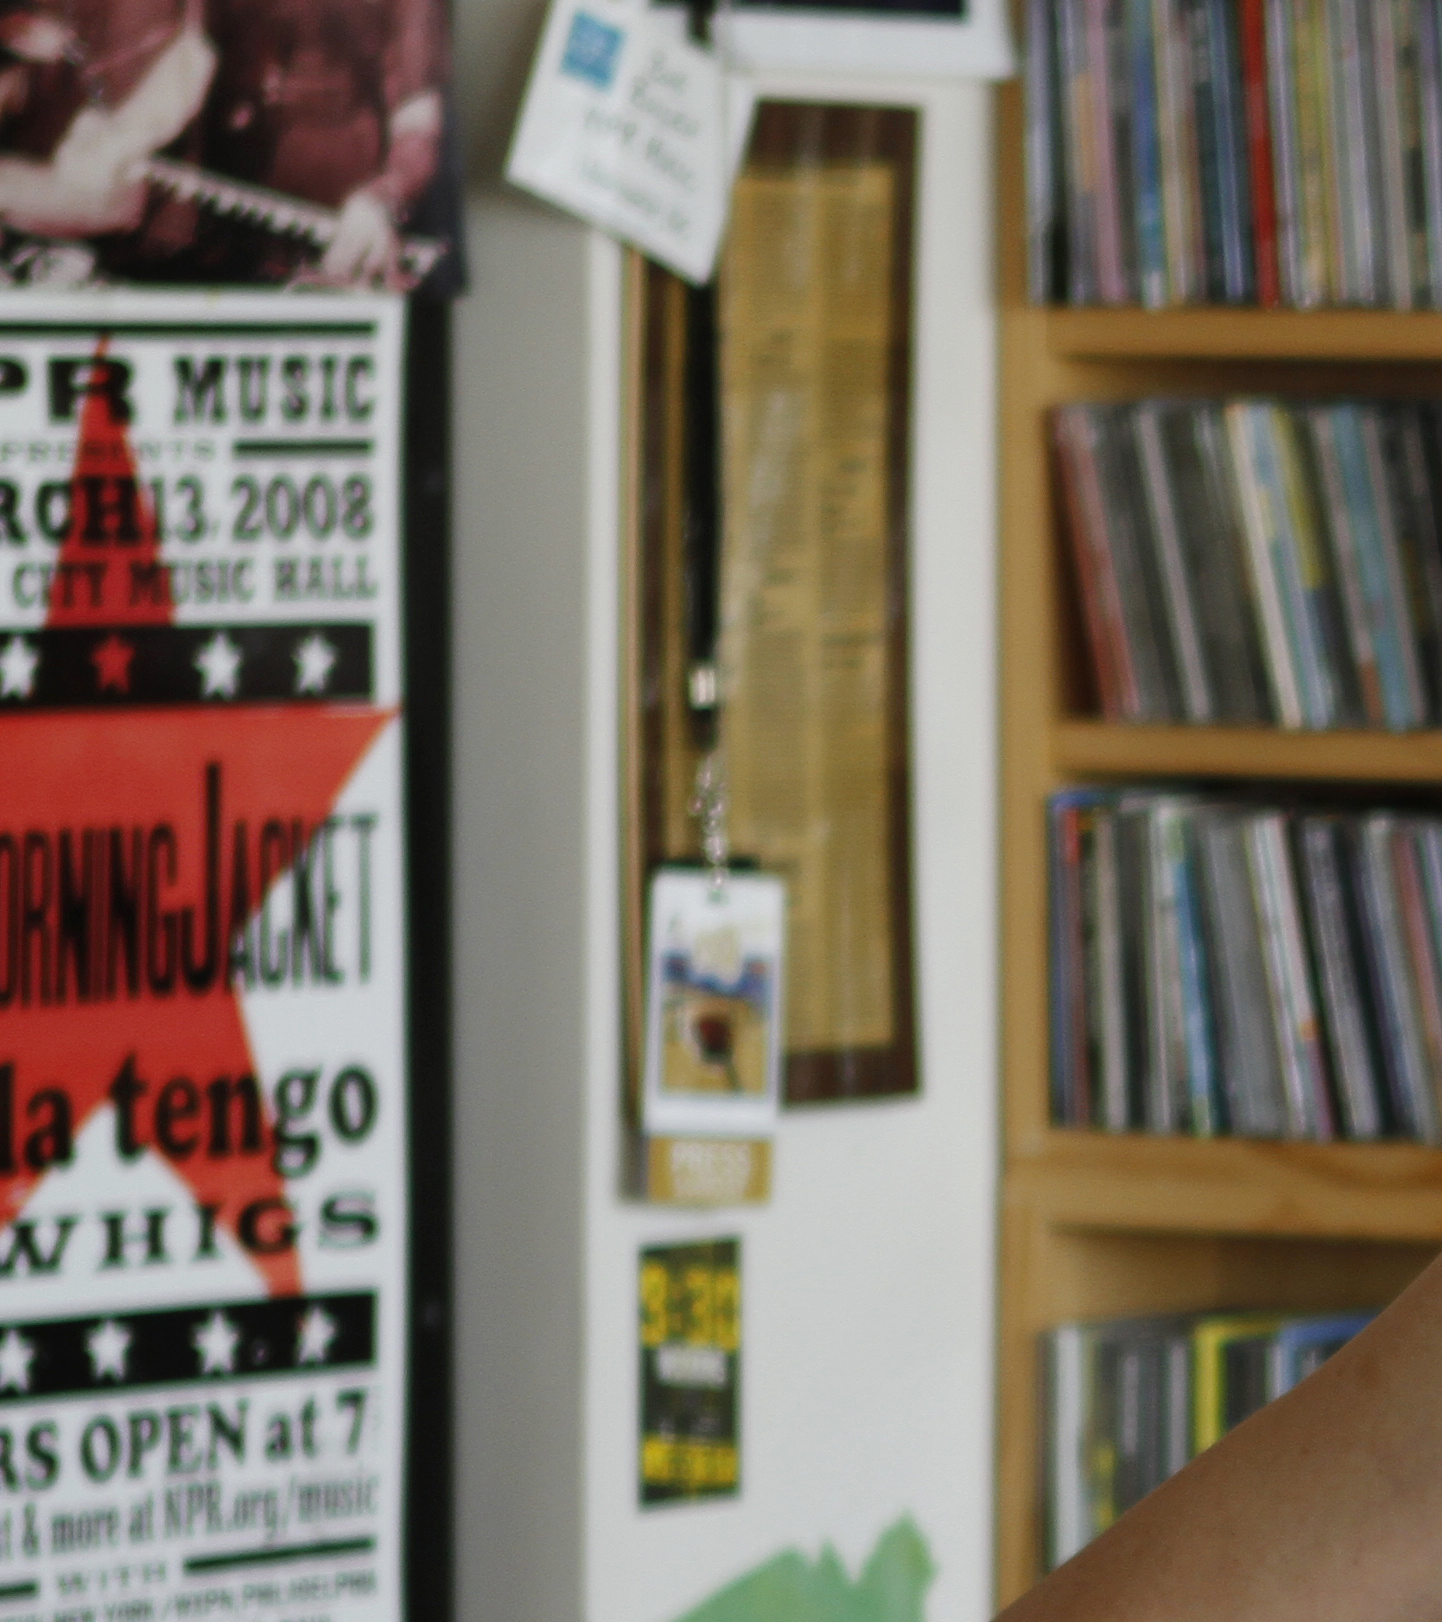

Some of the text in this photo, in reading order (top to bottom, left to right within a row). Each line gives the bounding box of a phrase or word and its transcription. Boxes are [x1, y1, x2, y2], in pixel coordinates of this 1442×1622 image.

[173, 355, 374, 424] MUSIC
[231, 474, 375, 541] 2008
[12, 555, 376, 607] CITY MUSIC HALL
[108, 1048, 378, 1179] tengo
[0, 1192, 381, 1278] WHIGS
[80, 1400, 248, 1483] OPEN
[265, 1394, 317, 1462] at
[335, 1389, 368, 1456] 7
[51, 1506, 119, 1552] more
